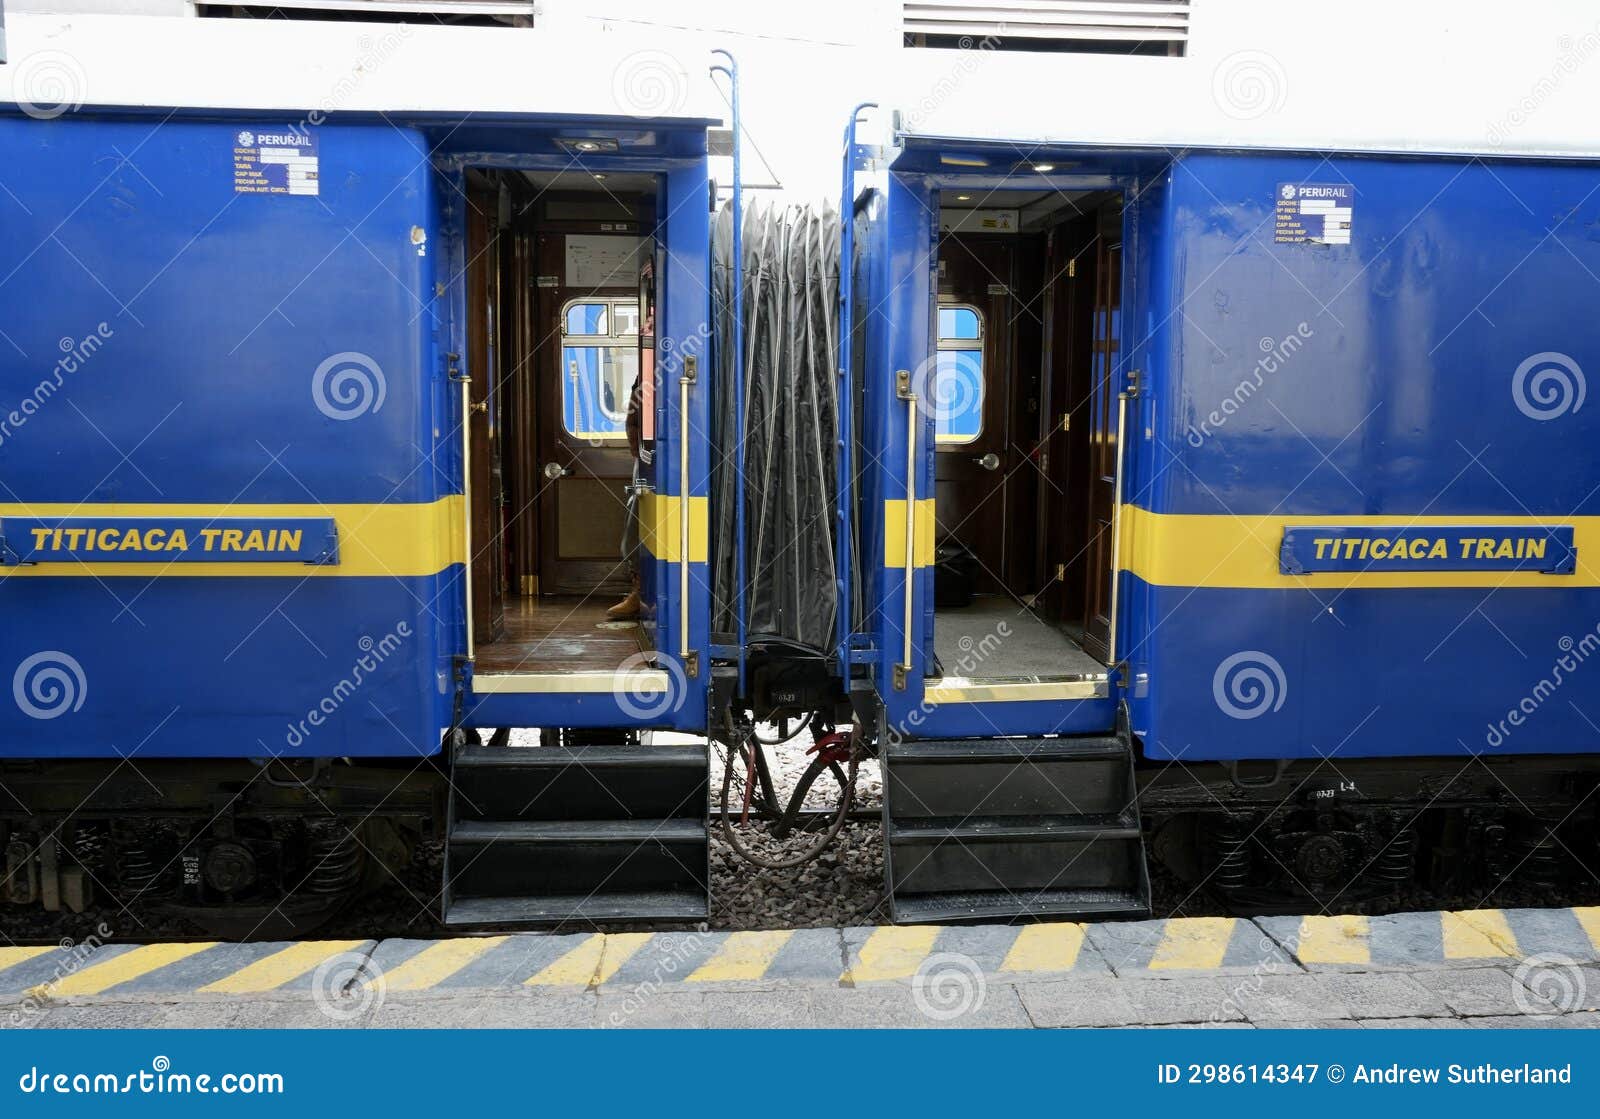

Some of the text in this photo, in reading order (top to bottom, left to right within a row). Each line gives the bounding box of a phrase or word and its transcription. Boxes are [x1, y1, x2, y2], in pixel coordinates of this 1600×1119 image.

[257, 134, 312, 146] PERURAIL
[1298, 187, 1348, 198] PERURAIL
[30, 527, 303, 552] TITICACA TRAIN
[1312, 538, 1547, 559] TITICACA TRAIN
